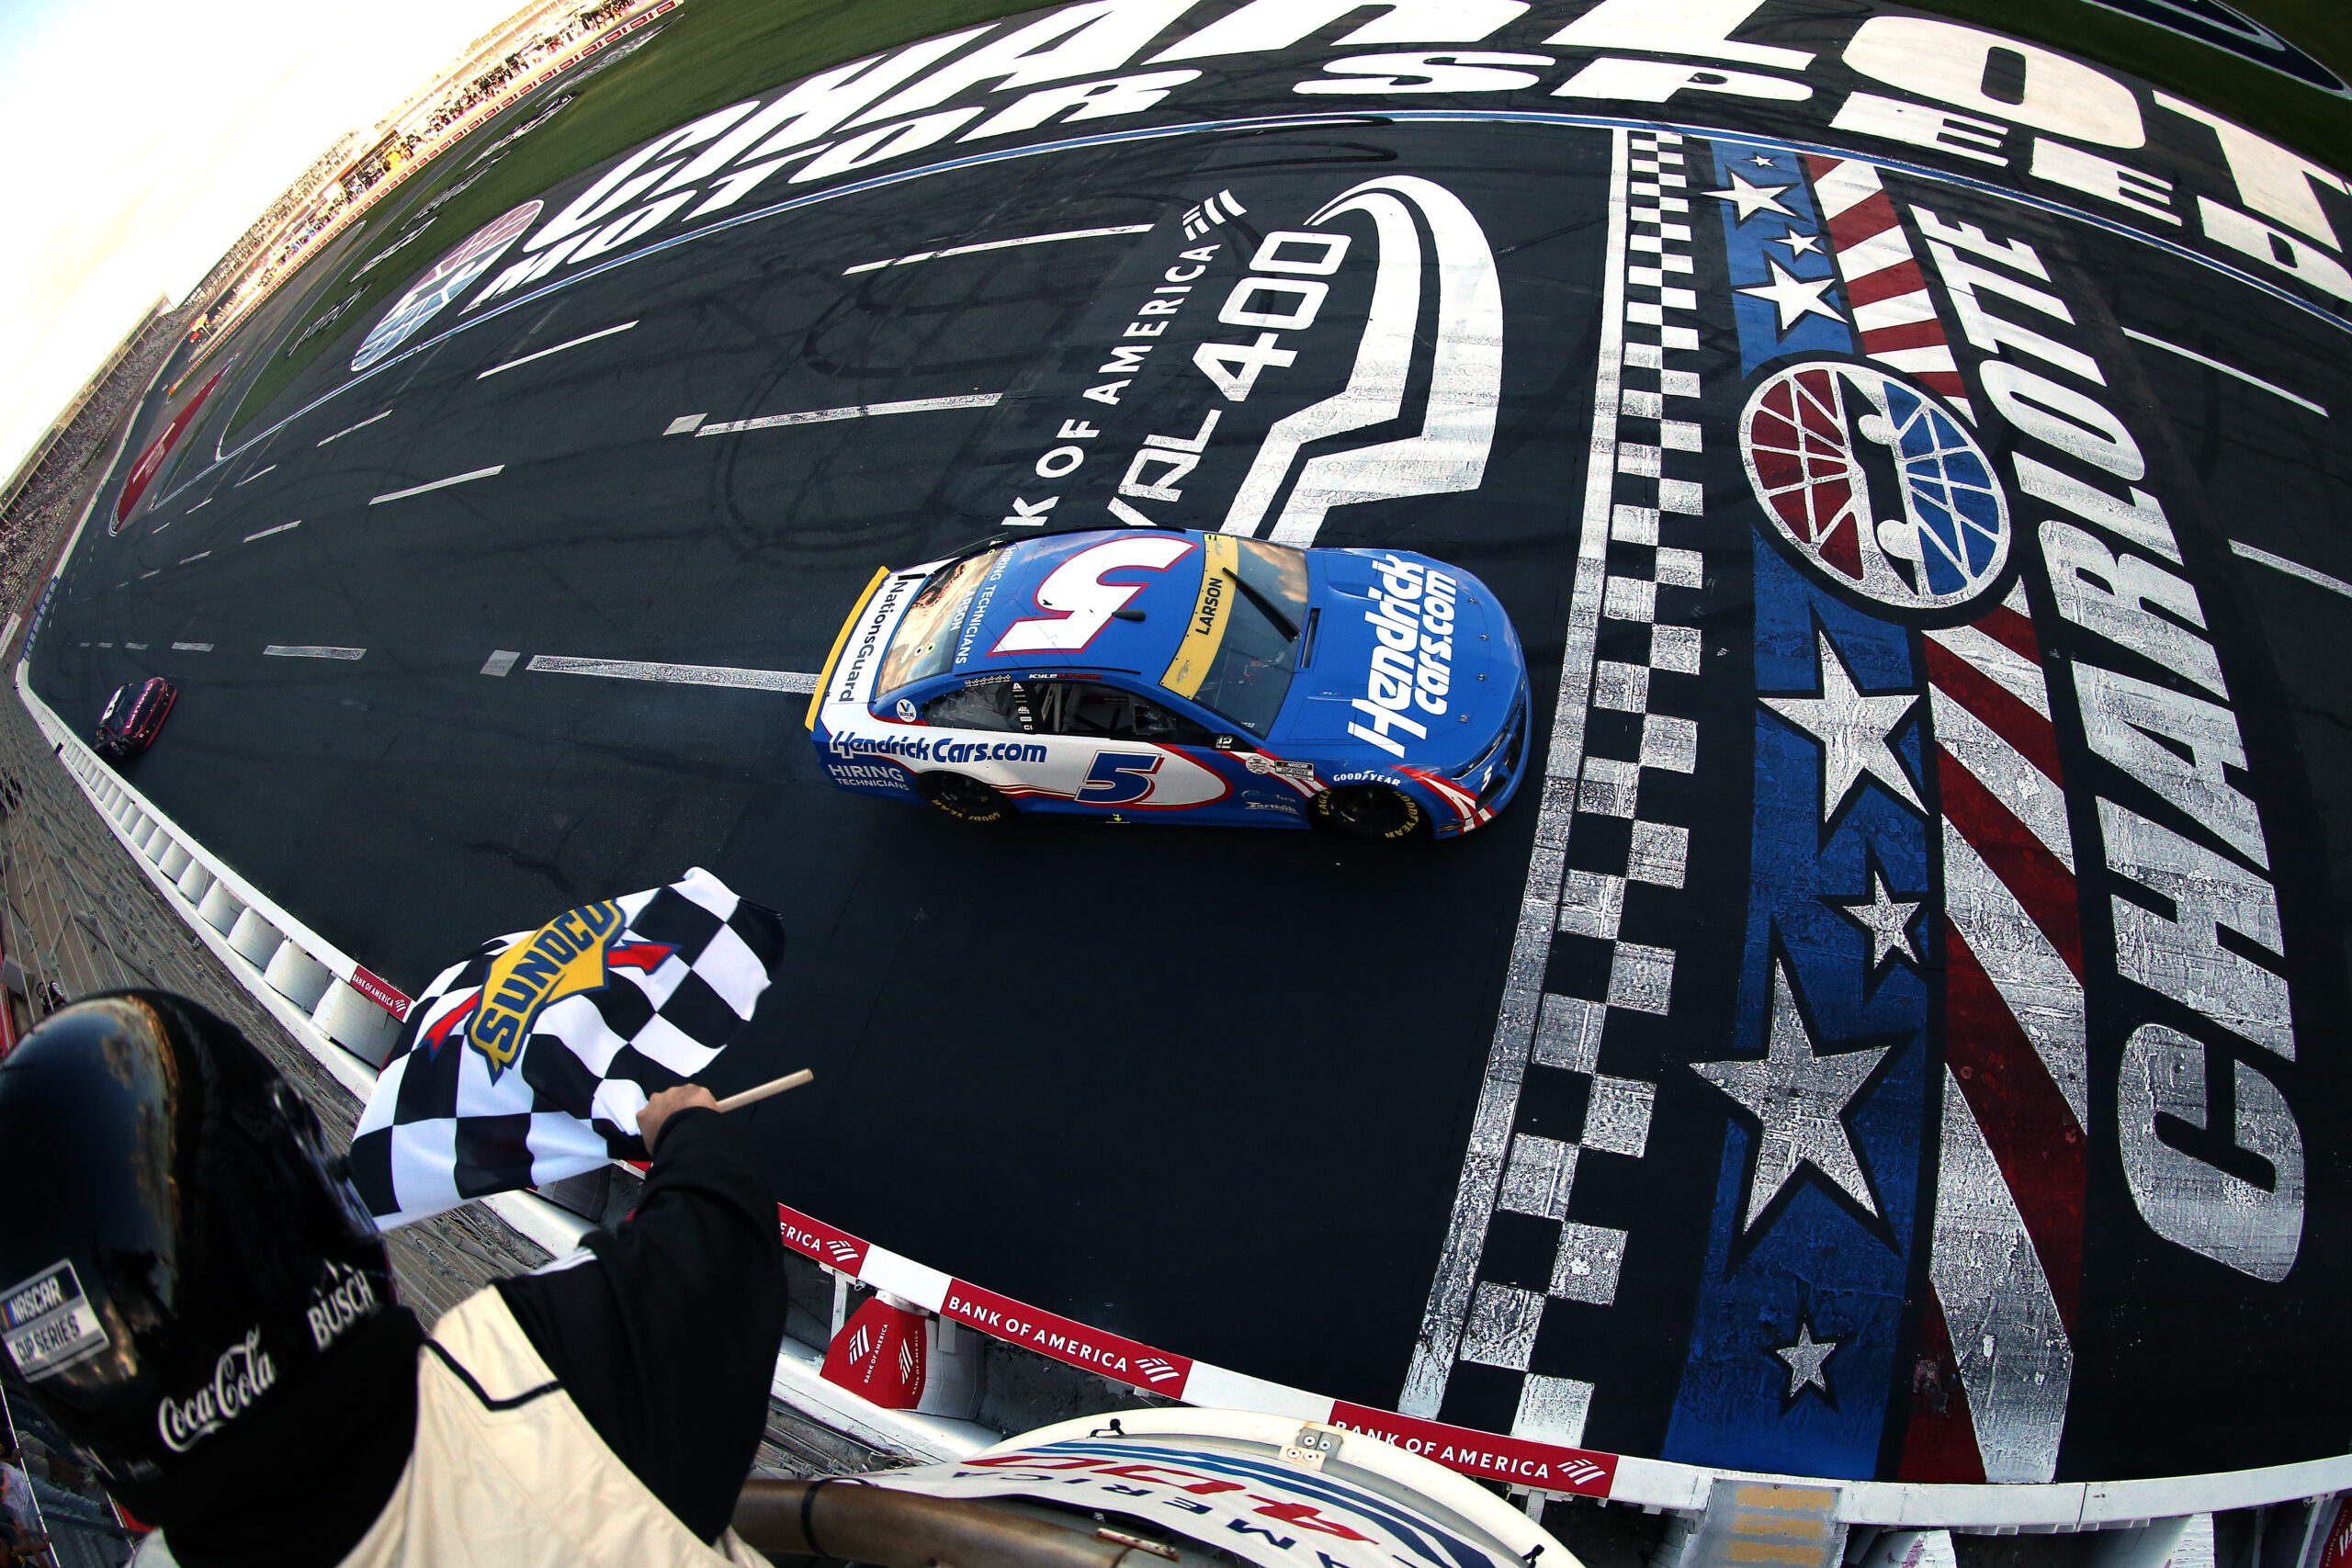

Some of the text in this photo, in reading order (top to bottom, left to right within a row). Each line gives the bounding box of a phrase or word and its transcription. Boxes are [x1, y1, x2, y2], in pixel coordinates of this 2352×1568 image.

[458, 69, 1203, 316] MOTOR
[1193, 231, 1352, 401] 400
[1035, 243, 1221, 479] OF AMERICA
[989, 546, 1017, 582] HIRING
[949, 583, 980, 632] LARSON
[955, 584, 998, 665] TECHNICIANS
[985, 535, 1201, 658] 5
[1195, 577, 1223, 636] LARSON
[838, 581, 909, 703] NationsGuard
[1347, 553, 1428, 759] Hendrick
[1908, 204, 2306, 1283] CHARLOTTE
[828, 763, 905, 783] HIRING
[835, 777, 910, 792] TECHNICIANS
[1074, 750, 1165, 807] 5
[1333, 770, 1401, 787] GOODYEAR
[1317, 789, 1332, 816] EAGLE
[352, 974, 394, 1008] BANK OF AMERICA
[779, 1223, 820, 1252] ERICA
[9, 1275, 63, 1325] NASCAR
[306, 1269, 376, 1352] BUSCH
[34, 1312, 81, 1354] SERIES
[864, 1365, 874, 1384] BANK
[874, 1324, 889, 1355] AMERICA
[948, 1296, 1127, 1372] BANK OF AMERICA
[1405, 1438, 1437, 1455] OF
[1440, 1446, 1549, 1479] AMERICA
